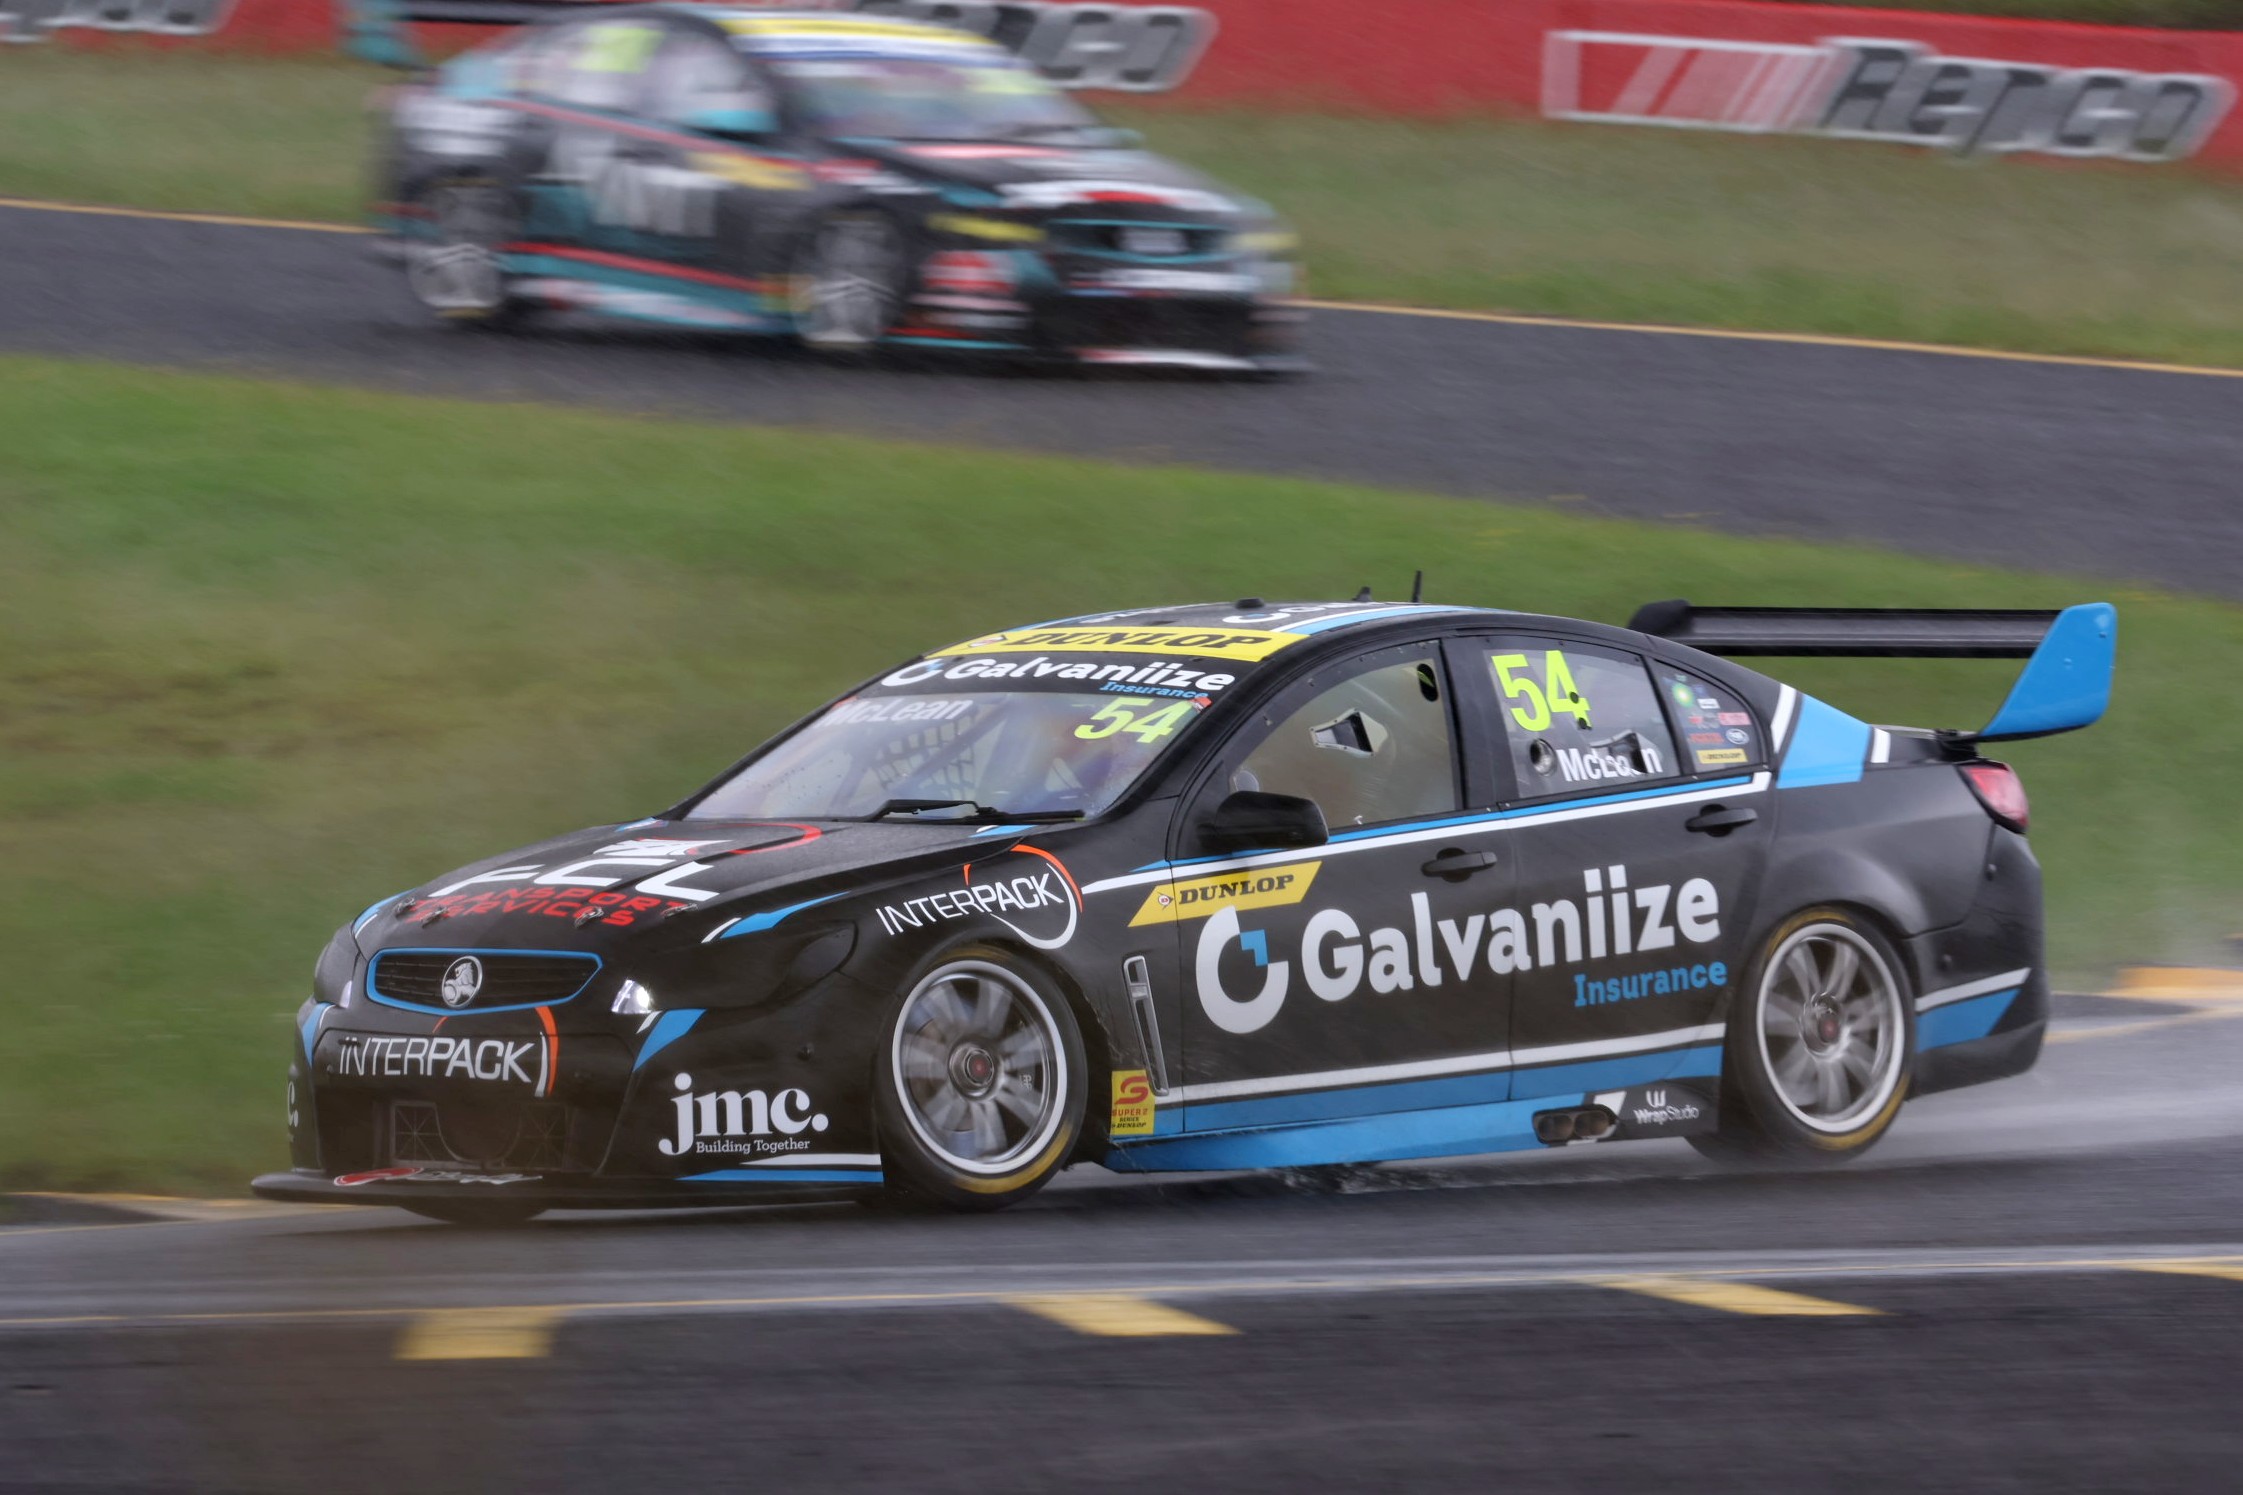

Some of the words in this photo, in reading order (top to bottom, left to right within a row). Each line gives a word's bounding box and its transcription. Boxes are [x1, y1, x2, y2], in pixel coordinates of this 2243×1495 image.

[1816, 46, 2207, 158] Repco
[1006, 631, 1273, 649] DUNLOP
[944, 656, 1236, 692] Galvaniize
[1099, 681, 1209, 700] Insurance
[1492, 649, 1593, 732] 54
[816, 699, 974, 728] McLean
[1074, 697, 1192, 744] 54
[1555, 747, 1664, 783] McLen
[429, 857, 721, 902] FCL
[1178, 873, 1295, 906] DUNLOP
[875, 872, 1065, 937] INTERPACK
[1301, 863, 1722, 1002] Galvaniize
[1573, 961, 1729, 1008] Insurance
[338, 1035, 536, 1084] INTERPACK
[696, 1139, 751, 1155] Building
[754, 1137, 810, 1154] Together
